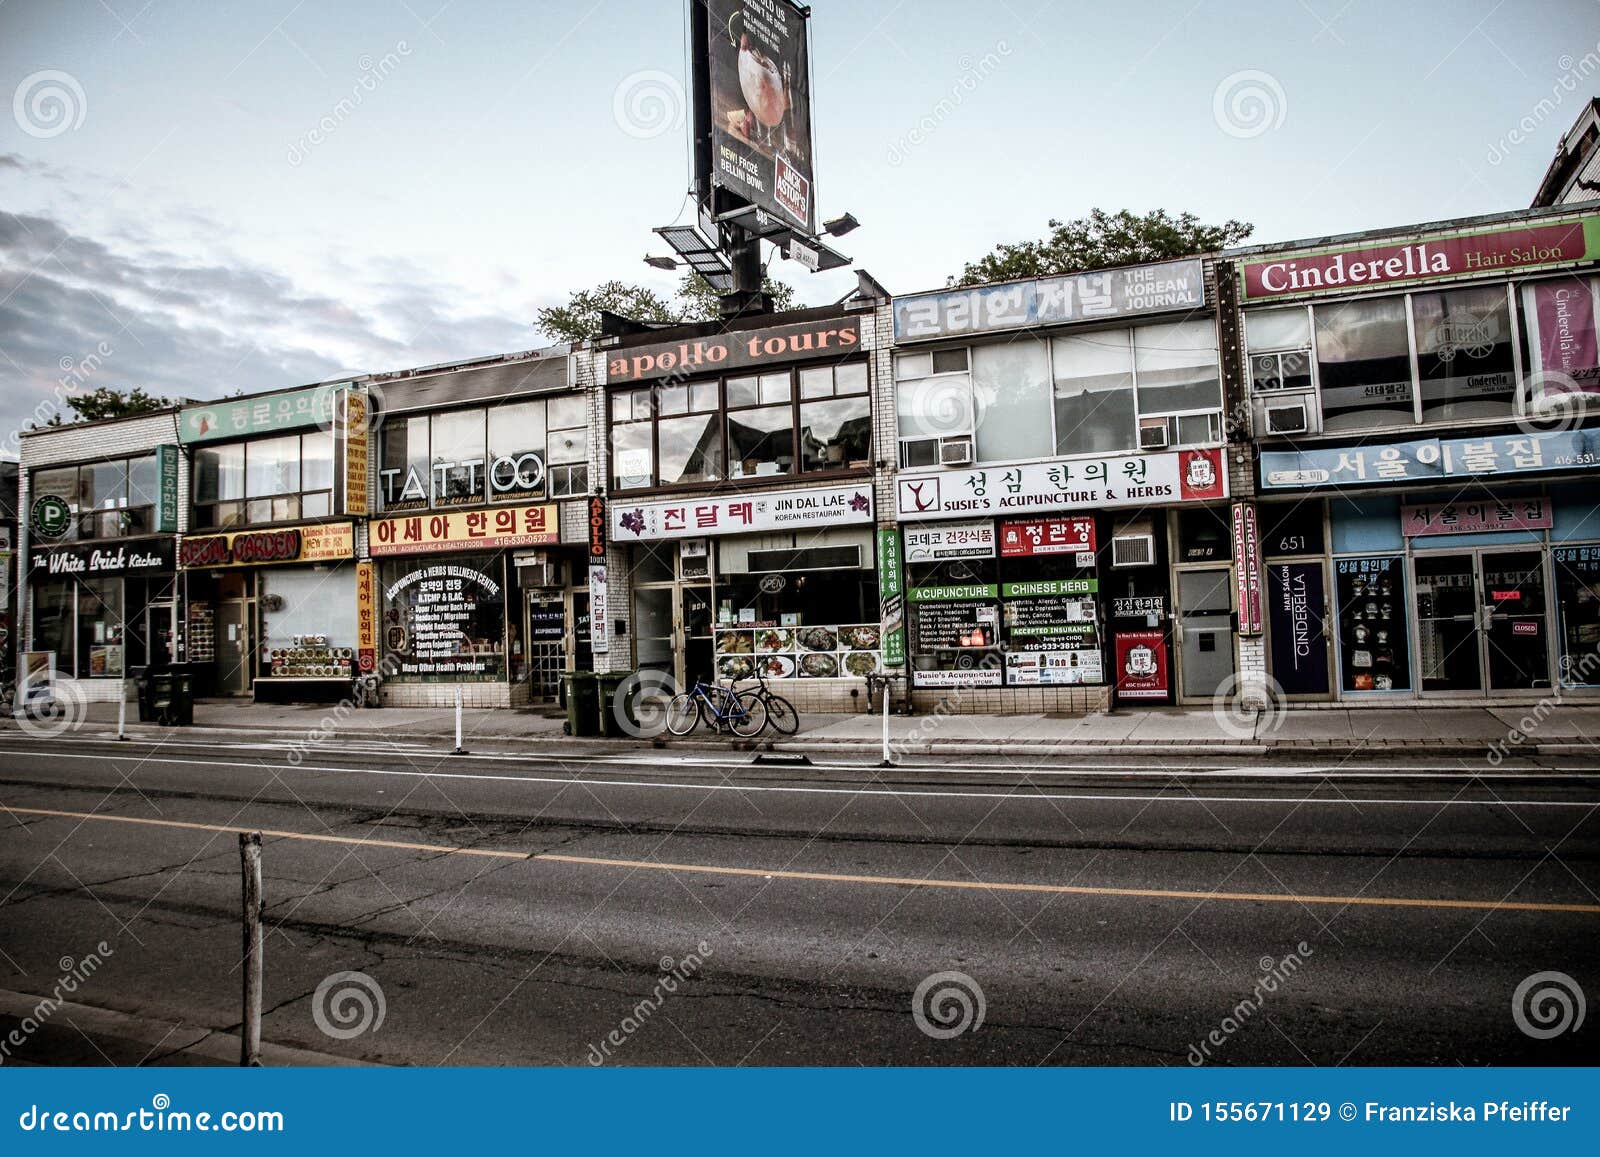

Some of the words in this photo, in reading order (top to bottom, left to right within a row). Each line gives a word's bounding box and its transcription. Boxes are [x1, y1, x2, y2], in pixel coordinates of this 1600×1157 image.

[720, 144, 738, 164] NEW!
[720, 158, 746, 182] BELLINI
[746, 172, 765, 193] BOWL
[777, 175, 806, 213] ASTOR'S
[1124, 270, 1155, 283] THE
[1260, 244, 1451, 292] Cinderella
[1464, 250, 1506, 269] Hair
[1509, 245, 1563, 264] Salon
[1125, 278, 1189, 298] KOREAN
[1124, 291, 1197, 311] JOURNAL
[1555, 289, 1574, 351] Cinderella
[609, 341, 728, 379] apollo
[747, 326, 857, 358] tours
[1335, 439, 1543, 480] 서울이불집
[380, 453, 544, 502] TATTOO
[965, 468, 1022, 497] 성심
[1047, 457, 1147, 492] 한의원
[775, 499, 793, 511] JIN
[796, 497, 820, 509] DAL
[823, 495, 846, 507] LAE
[944, 497, 992, 512] SUSIE'S
[1000, 489, 1098, 508] ACUPUNCTURE
[1106, 488, 1118, 500] &
[1127, 483, 1172, 499] HERBS
[377, 514, 450, 544] 아세아
[466, 506, 546, 538] 한의원
[664, 502, 753, 531] 진달래
[775, 512, 801, 522] KOREAN
[802, 509, 845, 520] RESTAURANT
[1412, 501, 1544, 526] 서울이불집
[591, 498, 604, 557] APOLLO
[907, 532, 943, 546] 코데코
[945, 529, 993, 545] 건강식품
[1026, 522, 1091, 545] 정관장
[494, 535, 548, 546] 416-530-0522
[1234, 507, 1247, 592] Cinderella
[1245, 506, 1260, 591] Cinderella
[1279, 535, 1305, 551] 651
[33, 555, 48, 568] The
[49, 552, 86, 574] White
[89, 548, 126, 571] Brick
[128, 552, 163, 569] Kitchen
[886, 535, 898, 592] 성심한의원
[1077, 555, 1095, 563] 649
[359, 568, 371, 604] 아세아
[386, 570, 424, 602] ACUPUNCTURE
[428, 566, 447, 578] HERBS
[447, 566, 478, 582] WELLNESS
[476, 573, 500, 596] CENTRE
[1011, 582, 1057, 594] CHINESE
[1060, 581, 1089, 592] HERB
[1282, 565, 1290, 591] SALON
[916, 586, 989, 599] ACUPUNCTURE
[1114, 598, 1164, 611] 성심한의원
[1283, 592, 1292, 611] HAIR
[360, 608, 371, 645] 한의원
[1293, 573, 1309, 657] CINDERELLA
[1014, 627, 1049, 635] ACCEPTED
[1050, 626, 1091, 634] INSURANCE
[1514, 624, 1537, 632] CLOSED
[1024, 642, 1080, 651] 416-533-3814
[419, 663, 435, 672] Other
[436, 662, 456, 672] Health
[456, 661, 486, 671] Problems
[916, 671, 946, 679] Susie's
[948, 671, 1001, 680] Acupuncture
